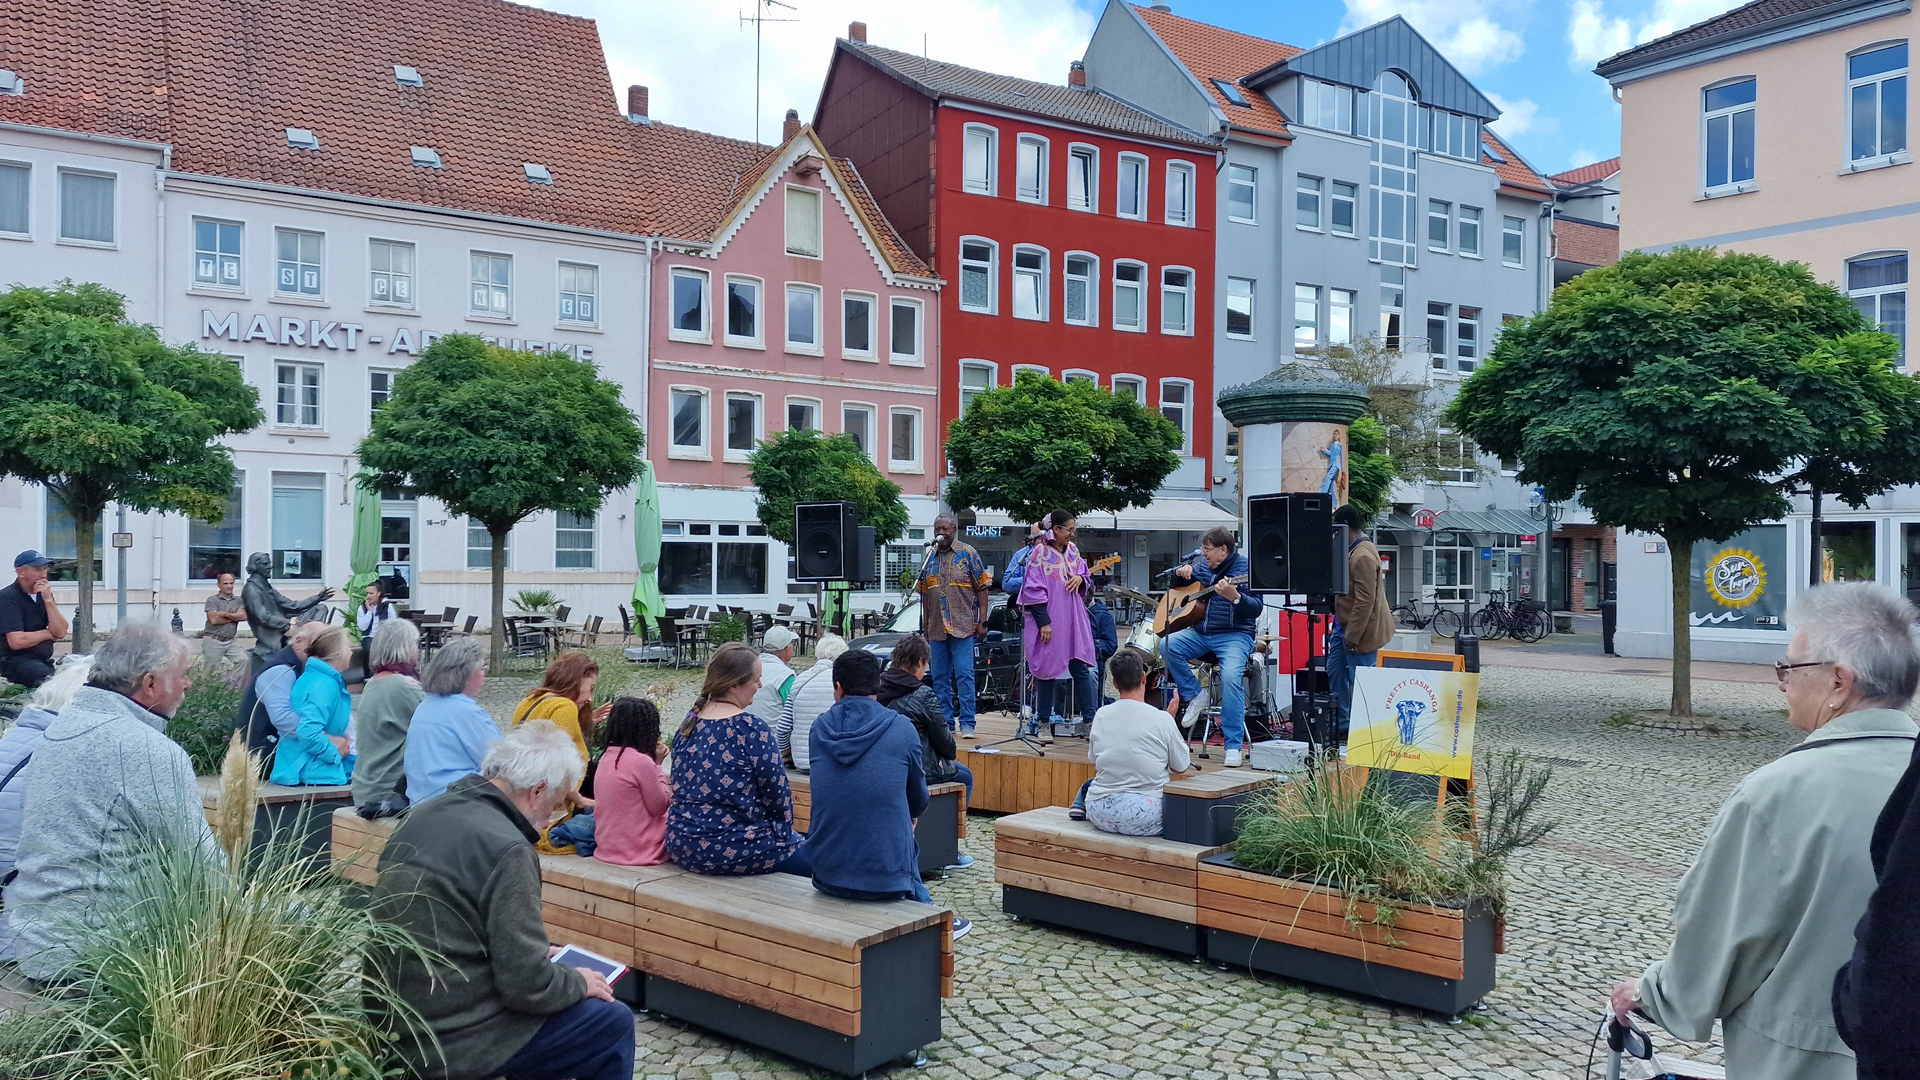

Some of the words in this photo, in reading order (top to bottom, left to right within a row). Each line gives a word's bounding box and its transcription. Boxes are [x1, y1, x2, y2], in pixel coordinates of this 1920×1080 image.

[202, 310, 593, 365] MARKT-APEE
[1415, 515, 1435, 527] LBS
[1706, 560, 1751, 580] Sun
[1718, 572, 1760, 593] Tropez
[1385, 680, 1407, 710] PRETTY
[1409, 678, 1438, 714] CASHANGA
[1452, 689, 1464, 759] www.cashanga.de
[1403, 752, 1421, 760] Band
